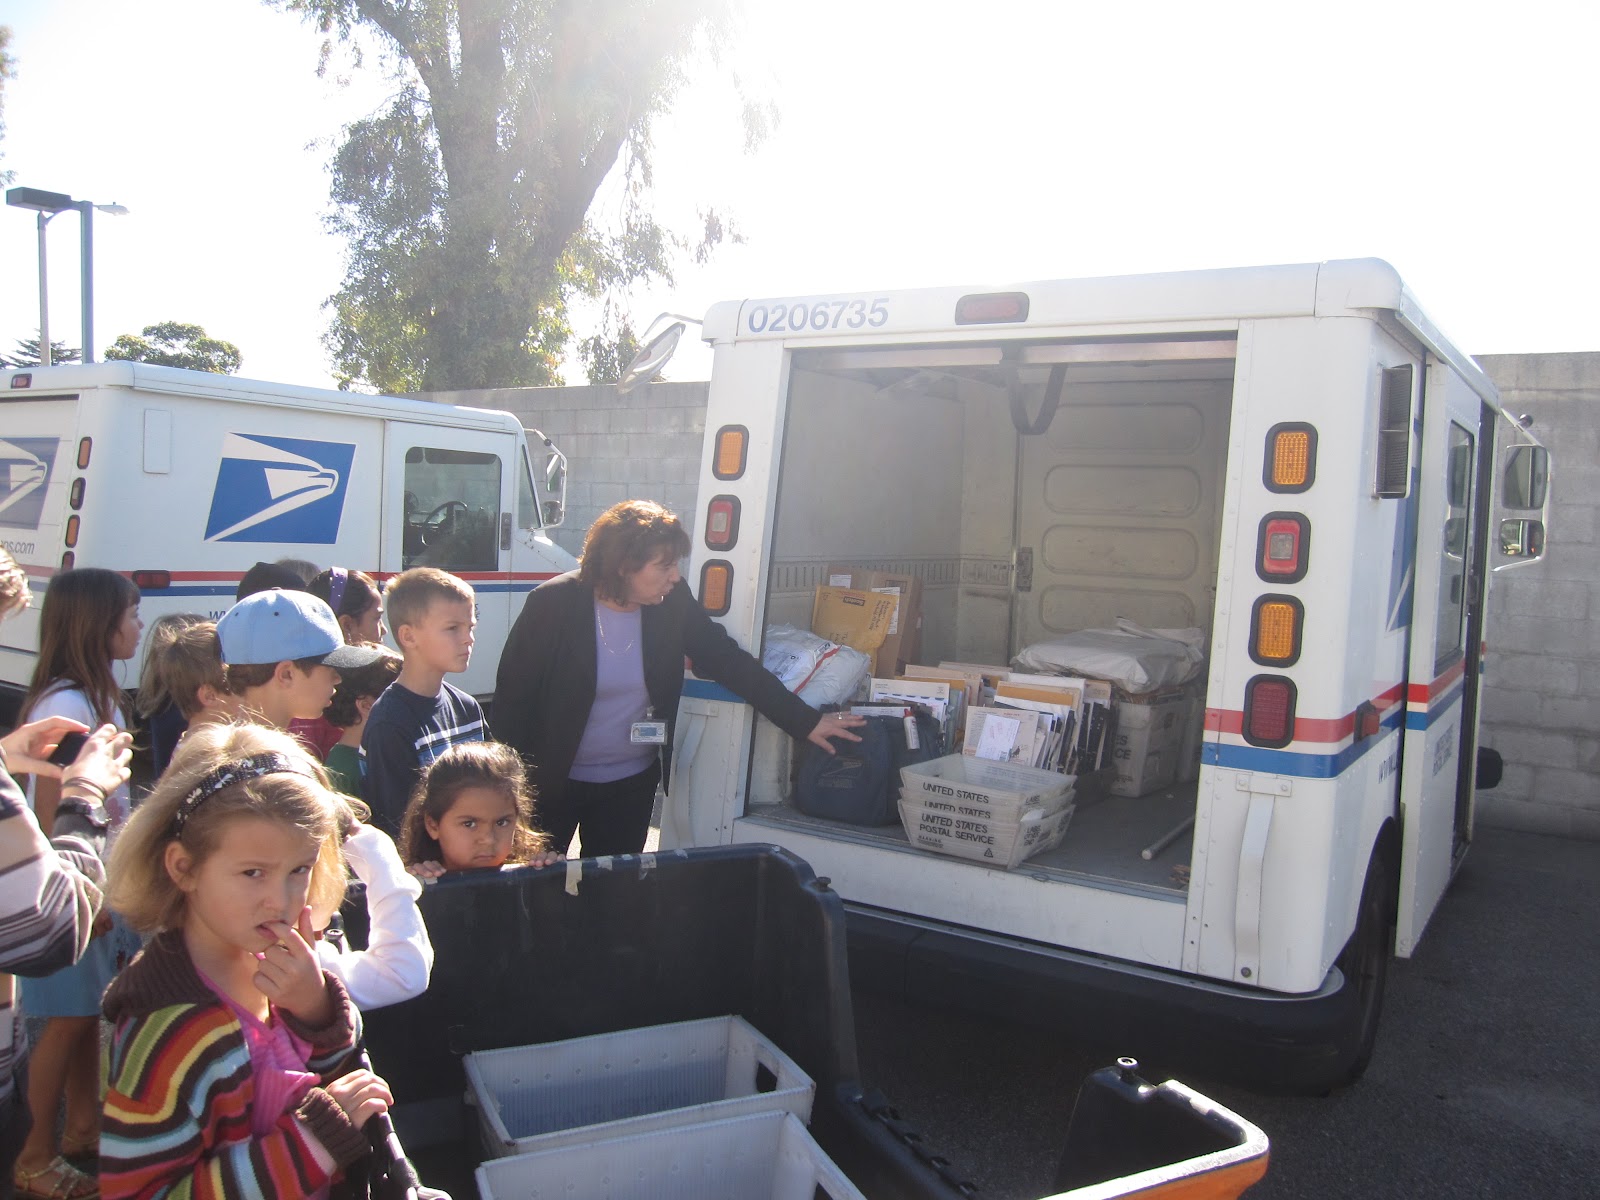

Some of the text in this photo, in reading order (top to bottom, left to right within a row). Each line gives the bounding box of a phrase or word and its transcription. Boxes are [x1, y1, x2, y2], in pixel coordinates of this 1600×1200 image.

[749, 298, 889, 332] 0206735
[923, 782, 989, 804] UNITED STATES
[922, 813, 988, 834] UNITED STATES
[958, 807, 991, 819] STATES
[920, 823, 953, 838] POSTAL
[955, 831, 995, 845] SERVICE
